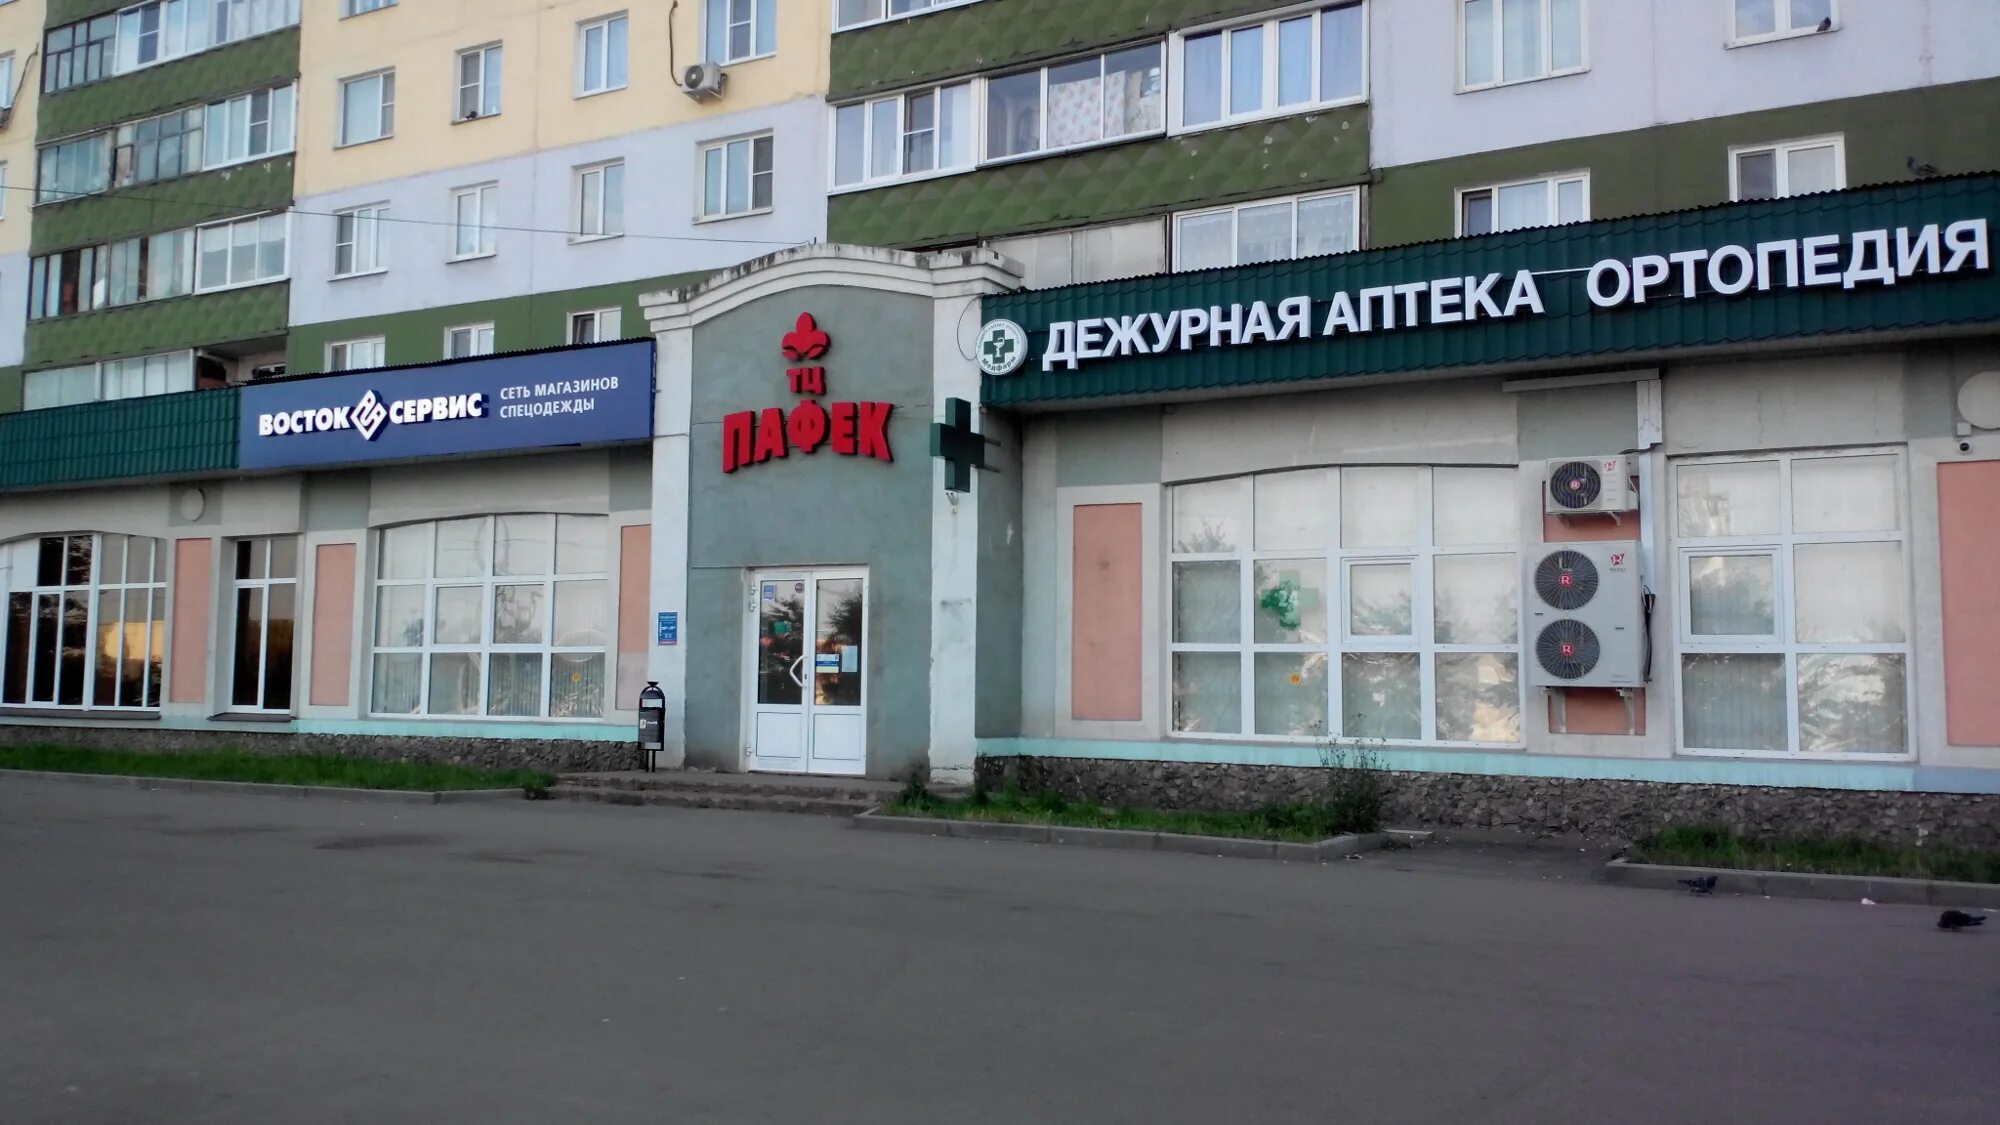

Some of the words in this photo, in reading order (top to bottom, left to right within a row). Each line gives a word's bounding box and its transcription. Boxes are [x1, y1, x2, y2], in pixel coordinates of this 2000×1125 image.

[1042, 295, 1311, 371] ДЕЖУРНАЯ
[1323, 269, 1545, 336] АПТЕКА
[1586, 218, 1990, 308] ОРТОПЕДИЯ
[500, 384, 531, 401] СЕТЬ
[534, 376, 619, 397] МАГАЗИНОВ
[786, 366, 826, 395] ТЦ
[259, 406, 351, 436] ВОСТОК
[389, 392, 484, 424] СЕРВИС
[499, 397, 595, 419] СПЕЦОДЕЖДЫ
[722, 400, 894, 473] ПАФЕК
